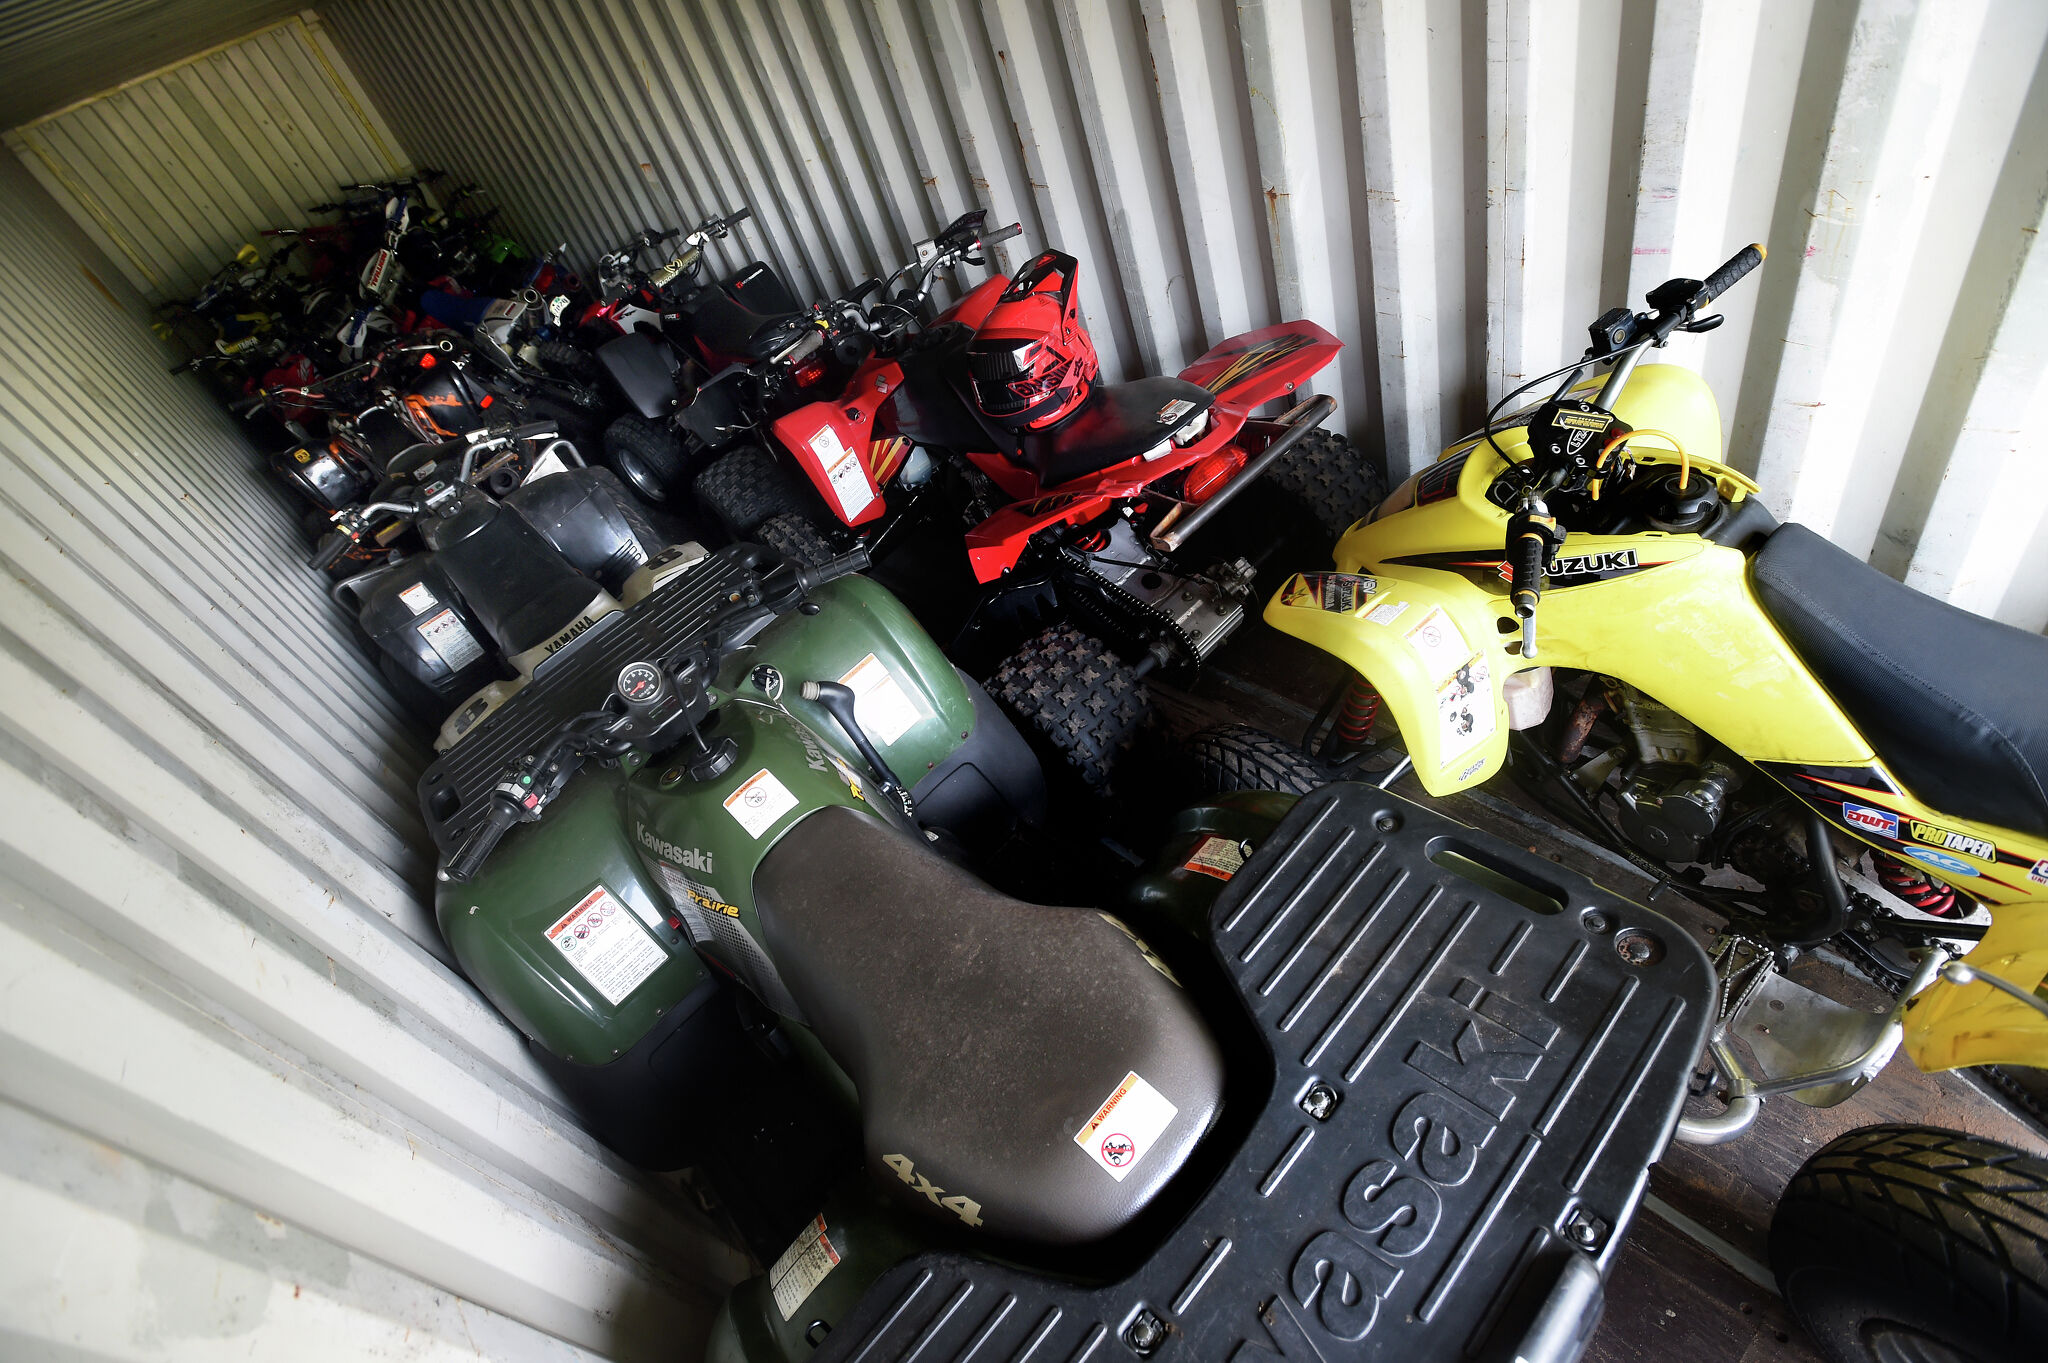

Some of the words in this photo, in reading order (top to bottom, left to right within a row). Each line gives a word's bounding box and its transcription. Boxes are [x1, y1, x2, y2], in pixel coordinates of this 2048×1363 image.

[1540, 549, 1638, 577] UZUKI
[1340, 580, 1354, 612] SUZUKI
[544, 615, 597, 654] YAMAHA
[636, 820, 713, 875] Kawasaki
[567, 899, 594, 924] WARNING
[686, 888, 740, 918] Prairie
[1097, 1088, 1127, 1122] WARNING
